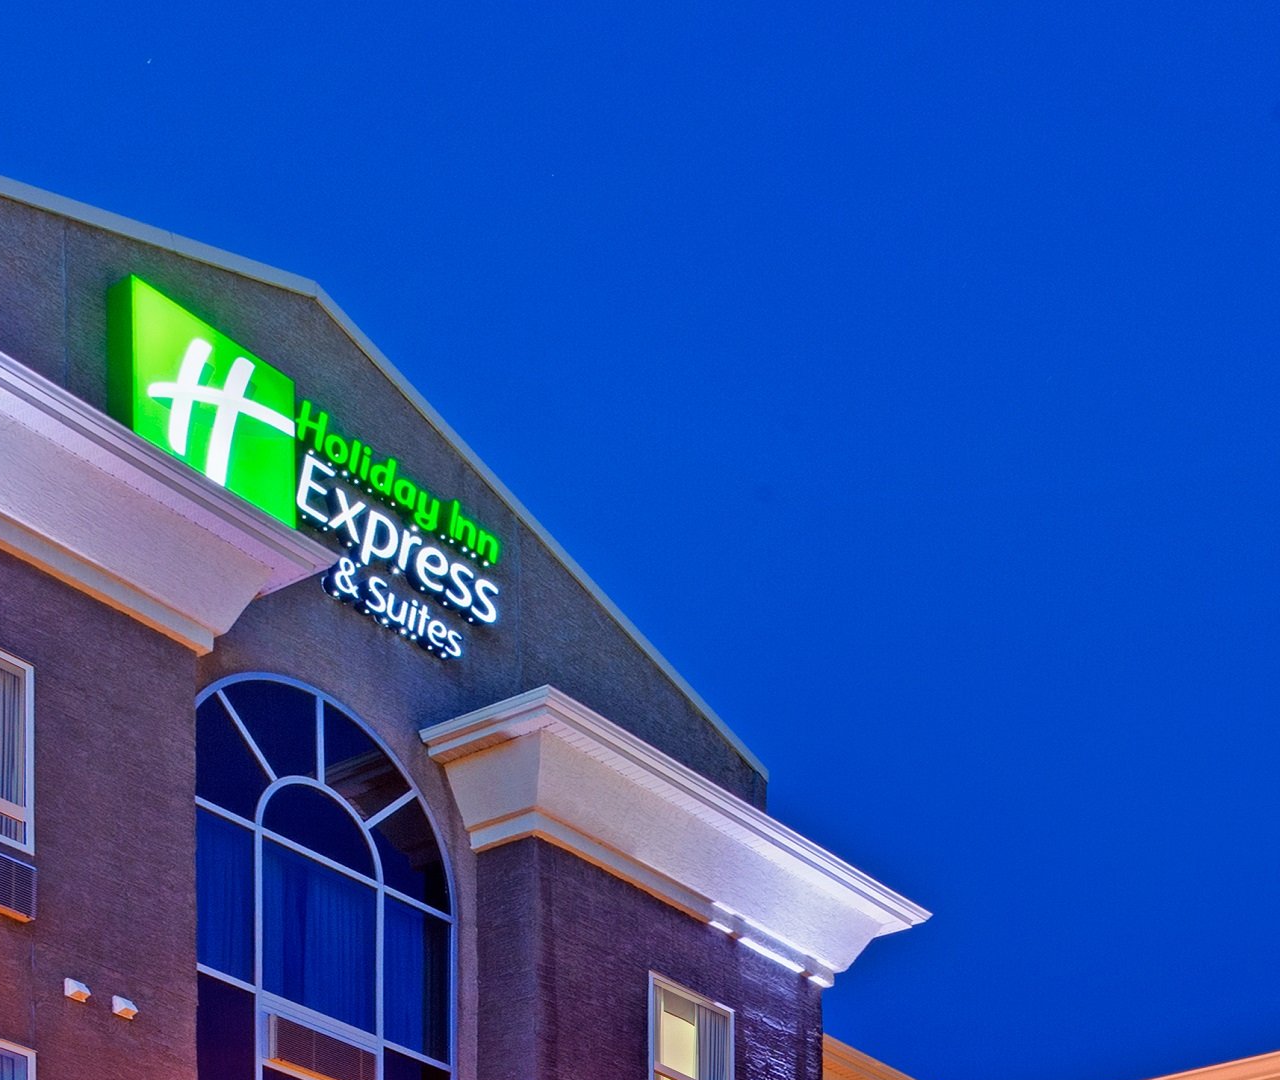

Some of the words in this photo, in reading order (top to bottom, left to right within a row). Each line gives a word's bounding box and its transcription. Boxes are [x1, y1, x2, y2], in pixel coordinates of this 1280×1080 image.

[296, 400, 439, 531] Holiday
[450, 500, 499, 563] Inn
[296, 454, 499, 624] Express
[335, 557, 359, 599] &
[365, 576, 462, 657] Suites
